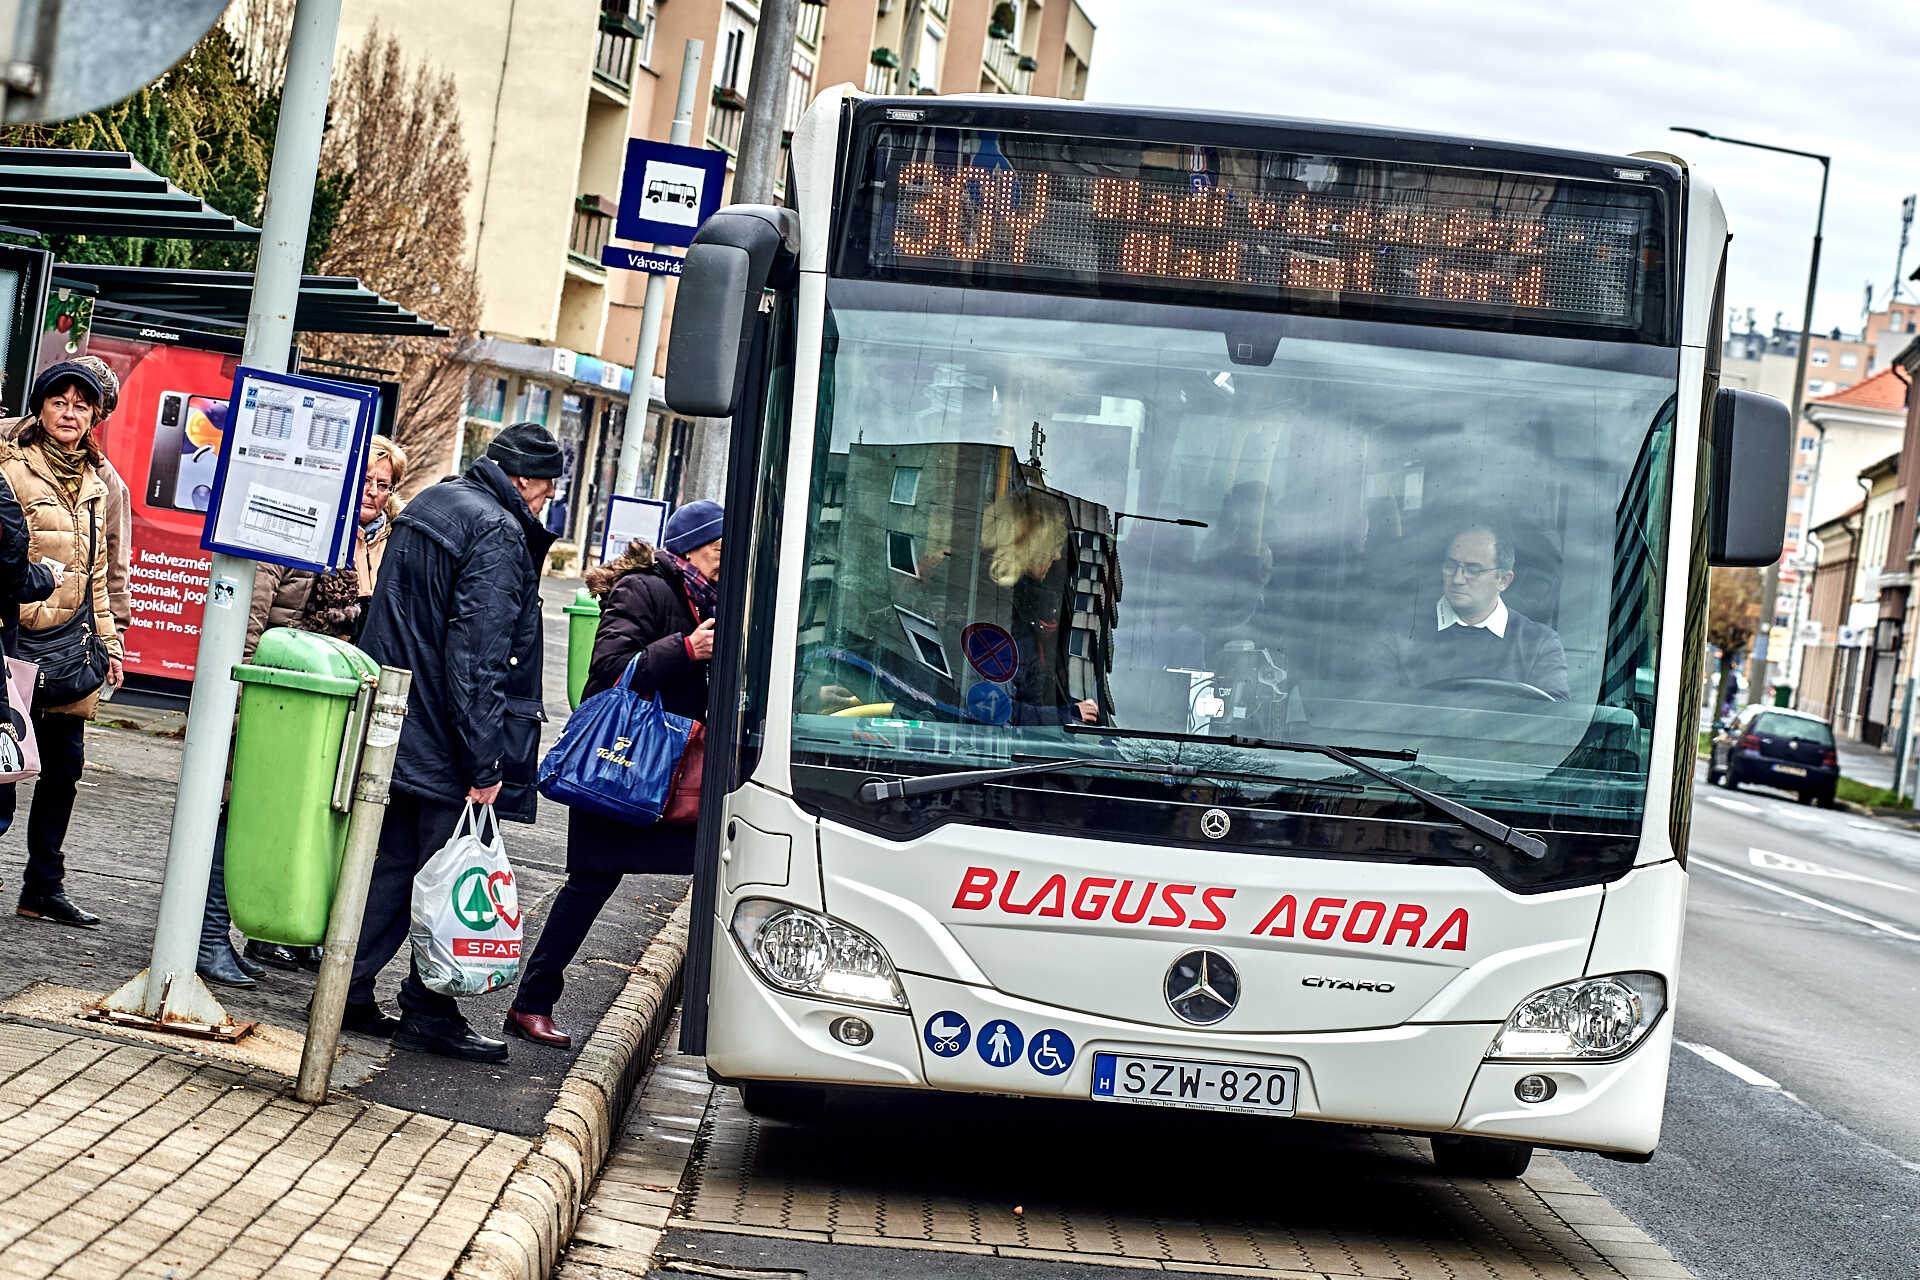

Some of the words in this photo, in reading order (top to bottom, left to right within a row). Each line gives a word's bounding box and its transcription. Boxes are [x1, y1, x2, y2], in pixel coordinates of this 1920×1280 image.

[1092, 178, 1226, 228] Oladi
[894, 163, 1049, 264] 30Y
[627, 253, 684, 273] Városhá
[1415, 257, 1551, 307] ford.
[139, 328, 180, 341] JCDecaux
[130, 616, 153, 629] Note
[155, 621, 165, 630] 11
[166, 623, 183, 633] Pro
[596, 747, 636, 768] Tchibo
[951, 866, 1238, 931] BLAGUSS
[1249, 894, 1470, 952] AGORA
[467, 941, 521, 956] SPAR
[1301, 975, 1397, 994] CITARO
[1099, 1077, 1110, 1090] H
[1123, 1062, 1286, 1106] SZW-820
